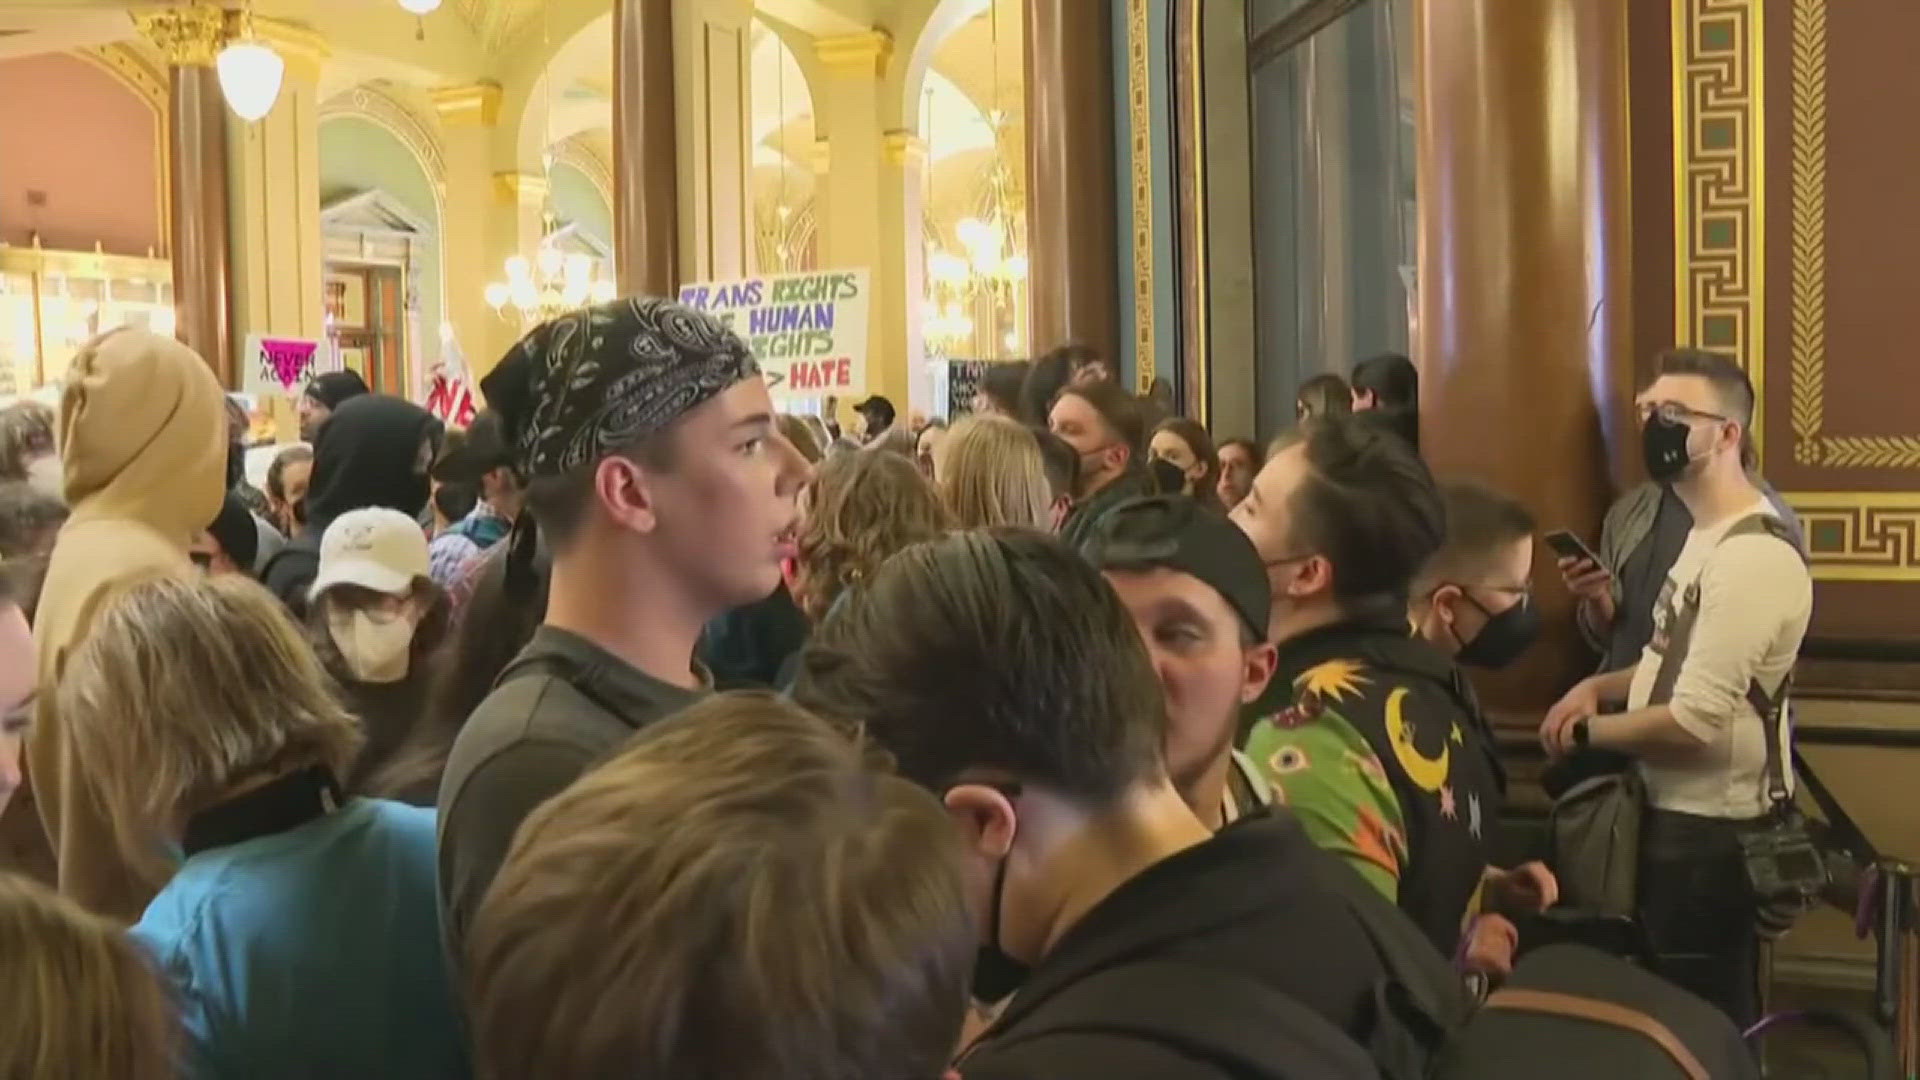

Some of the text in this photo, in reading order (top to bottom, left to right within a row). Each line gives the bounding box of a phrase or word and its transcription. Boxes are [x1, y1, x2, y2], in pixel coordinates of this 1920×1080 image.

[680, 273, 858, 310] TRANS RIGHTS
[750, 303, 834, 335] HUMAN
[260, 350, 315, 368] NEVER
[790, 358, 850, 389] HATE
